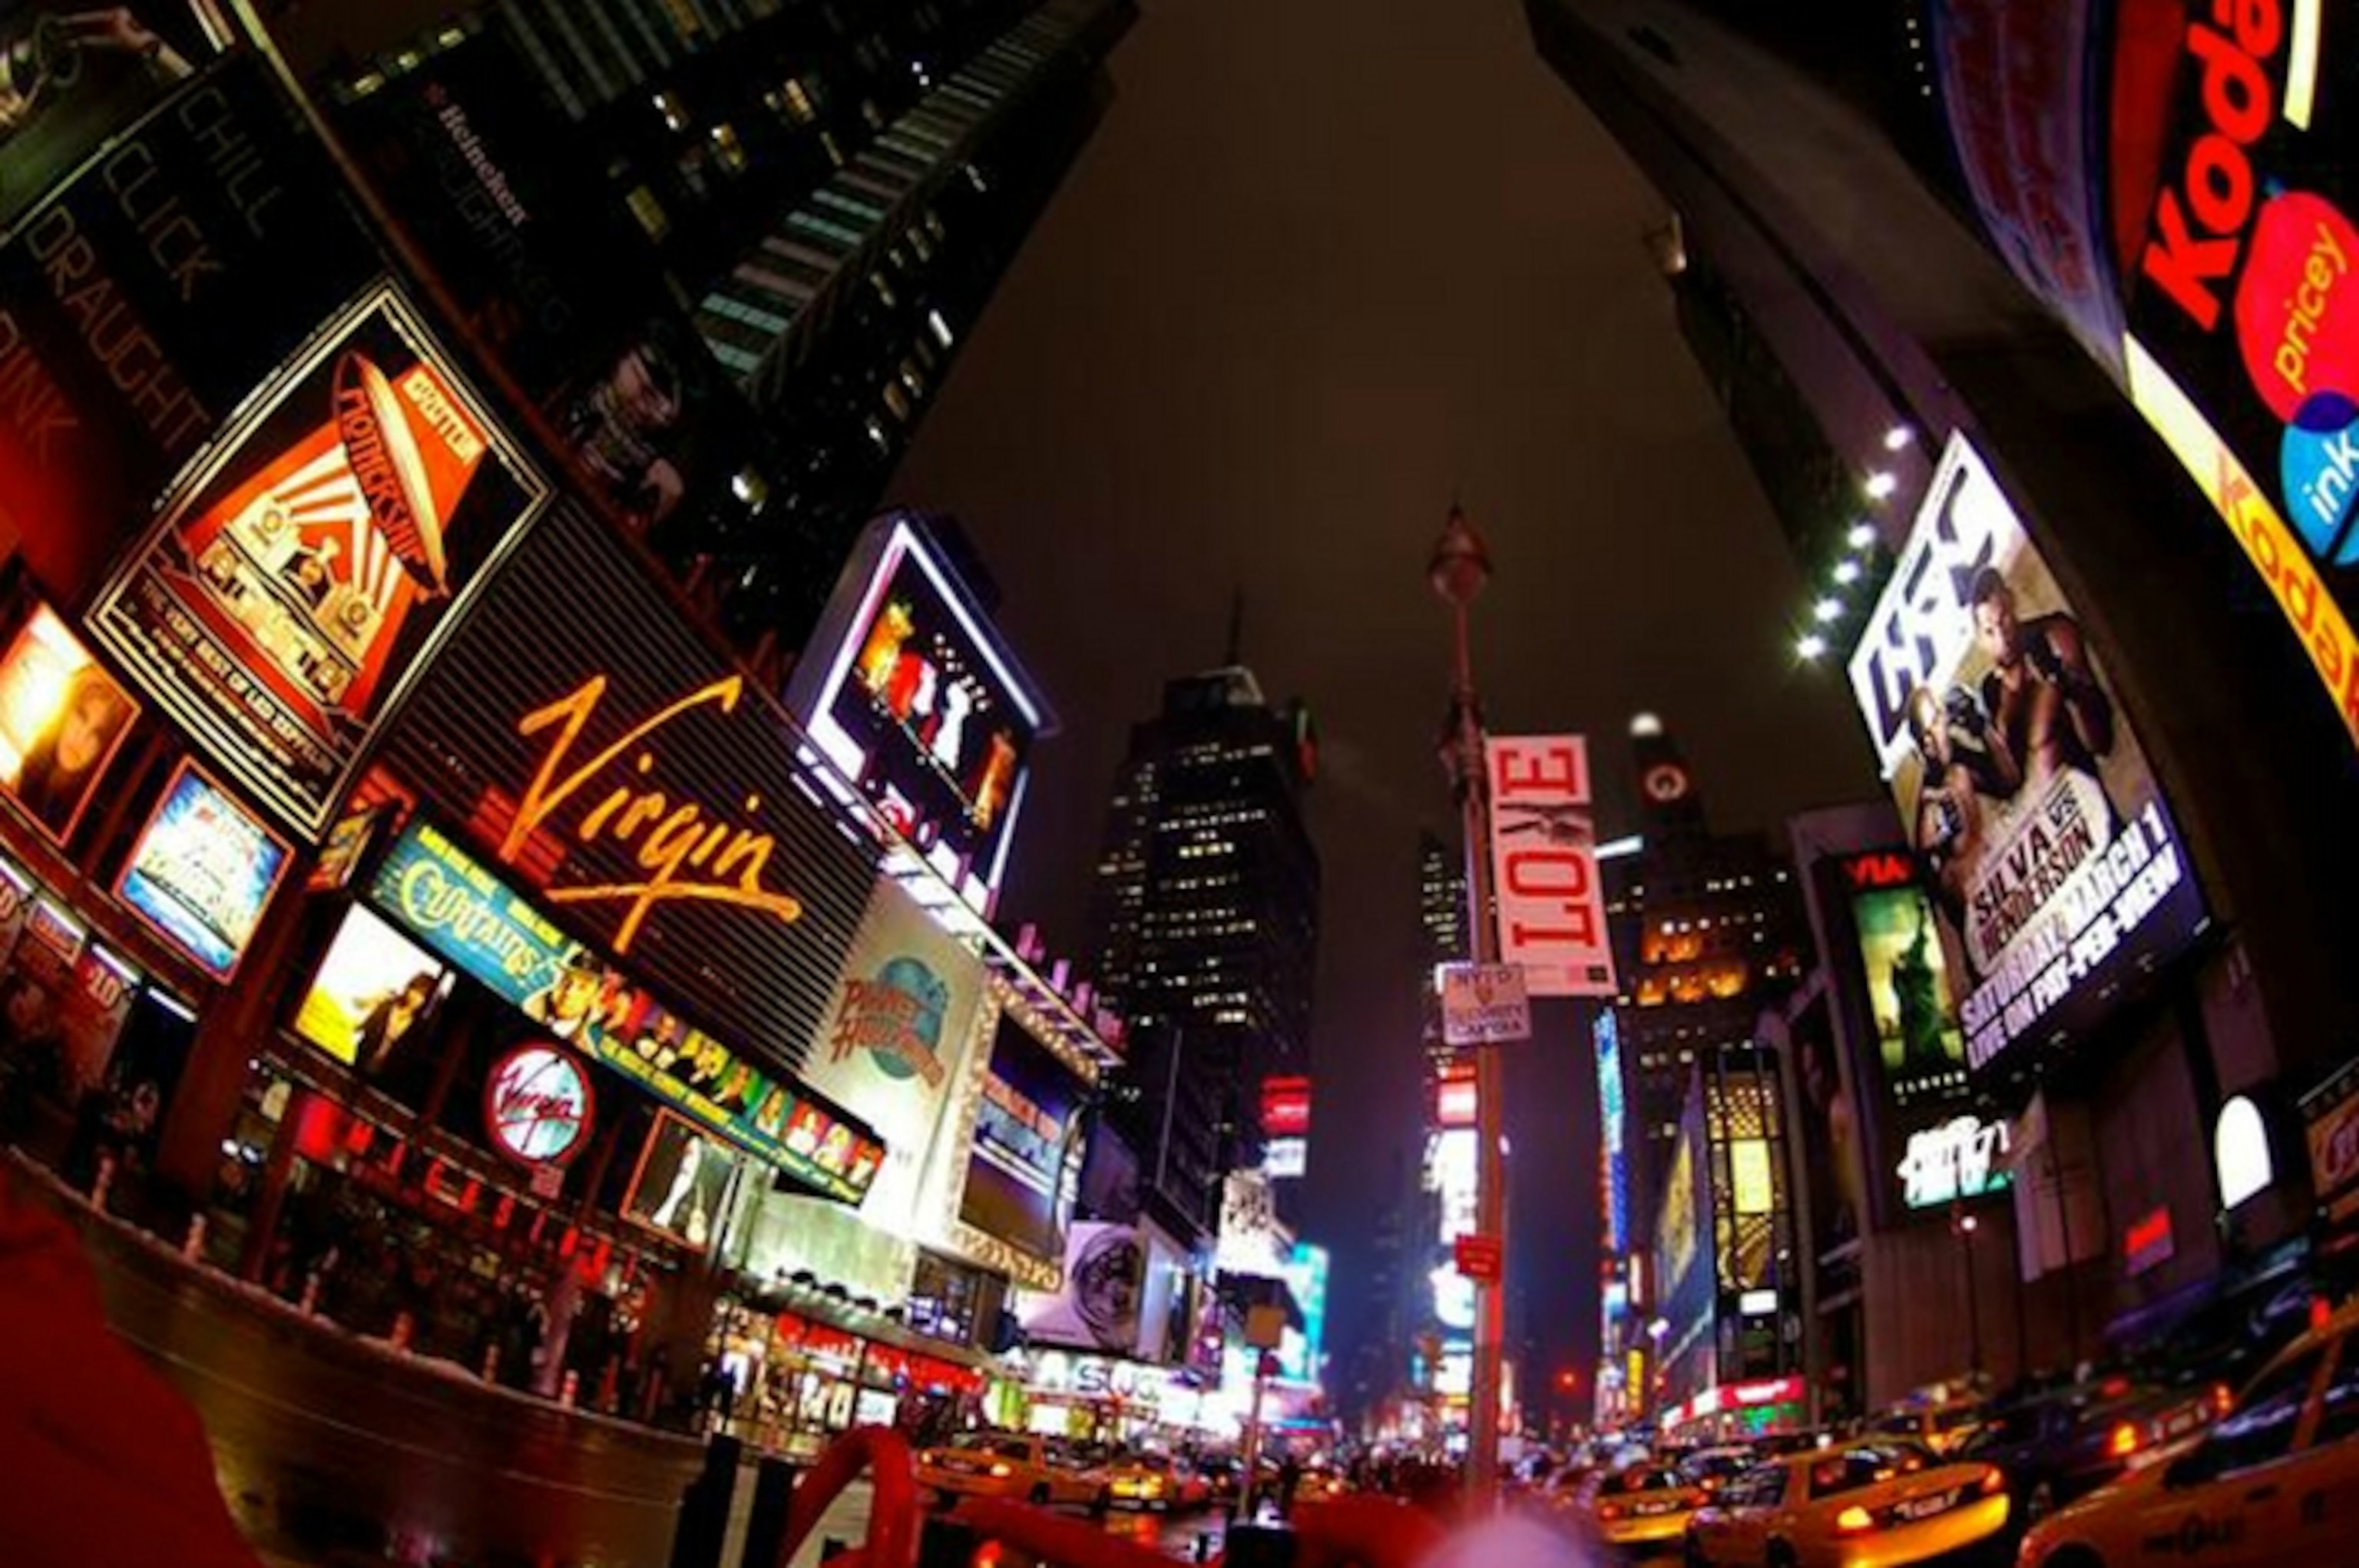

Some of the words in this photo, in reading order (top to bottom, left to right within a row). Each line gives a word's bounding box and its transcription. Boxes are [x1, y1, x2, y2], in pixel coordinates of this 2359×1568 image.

[102, 139, 229, 306] CLICK
[178, 85, 286, 242] CHILL
[438, 102, 530, 227] Heineken
[25, 203, 213, 451] DRAUGHT
[2275, 223, 2347, 395] pricey
[338, 386, 427, 568] MOTHERSHIP
[2303, 428, 2359, 526] ink
[498, 675, 802, 954] Virgin
[1976, 825, 2051, 921] SILVA
[2141, 800, 2168, 845] 1
[498, 1053, 581, 1153] Virgin
